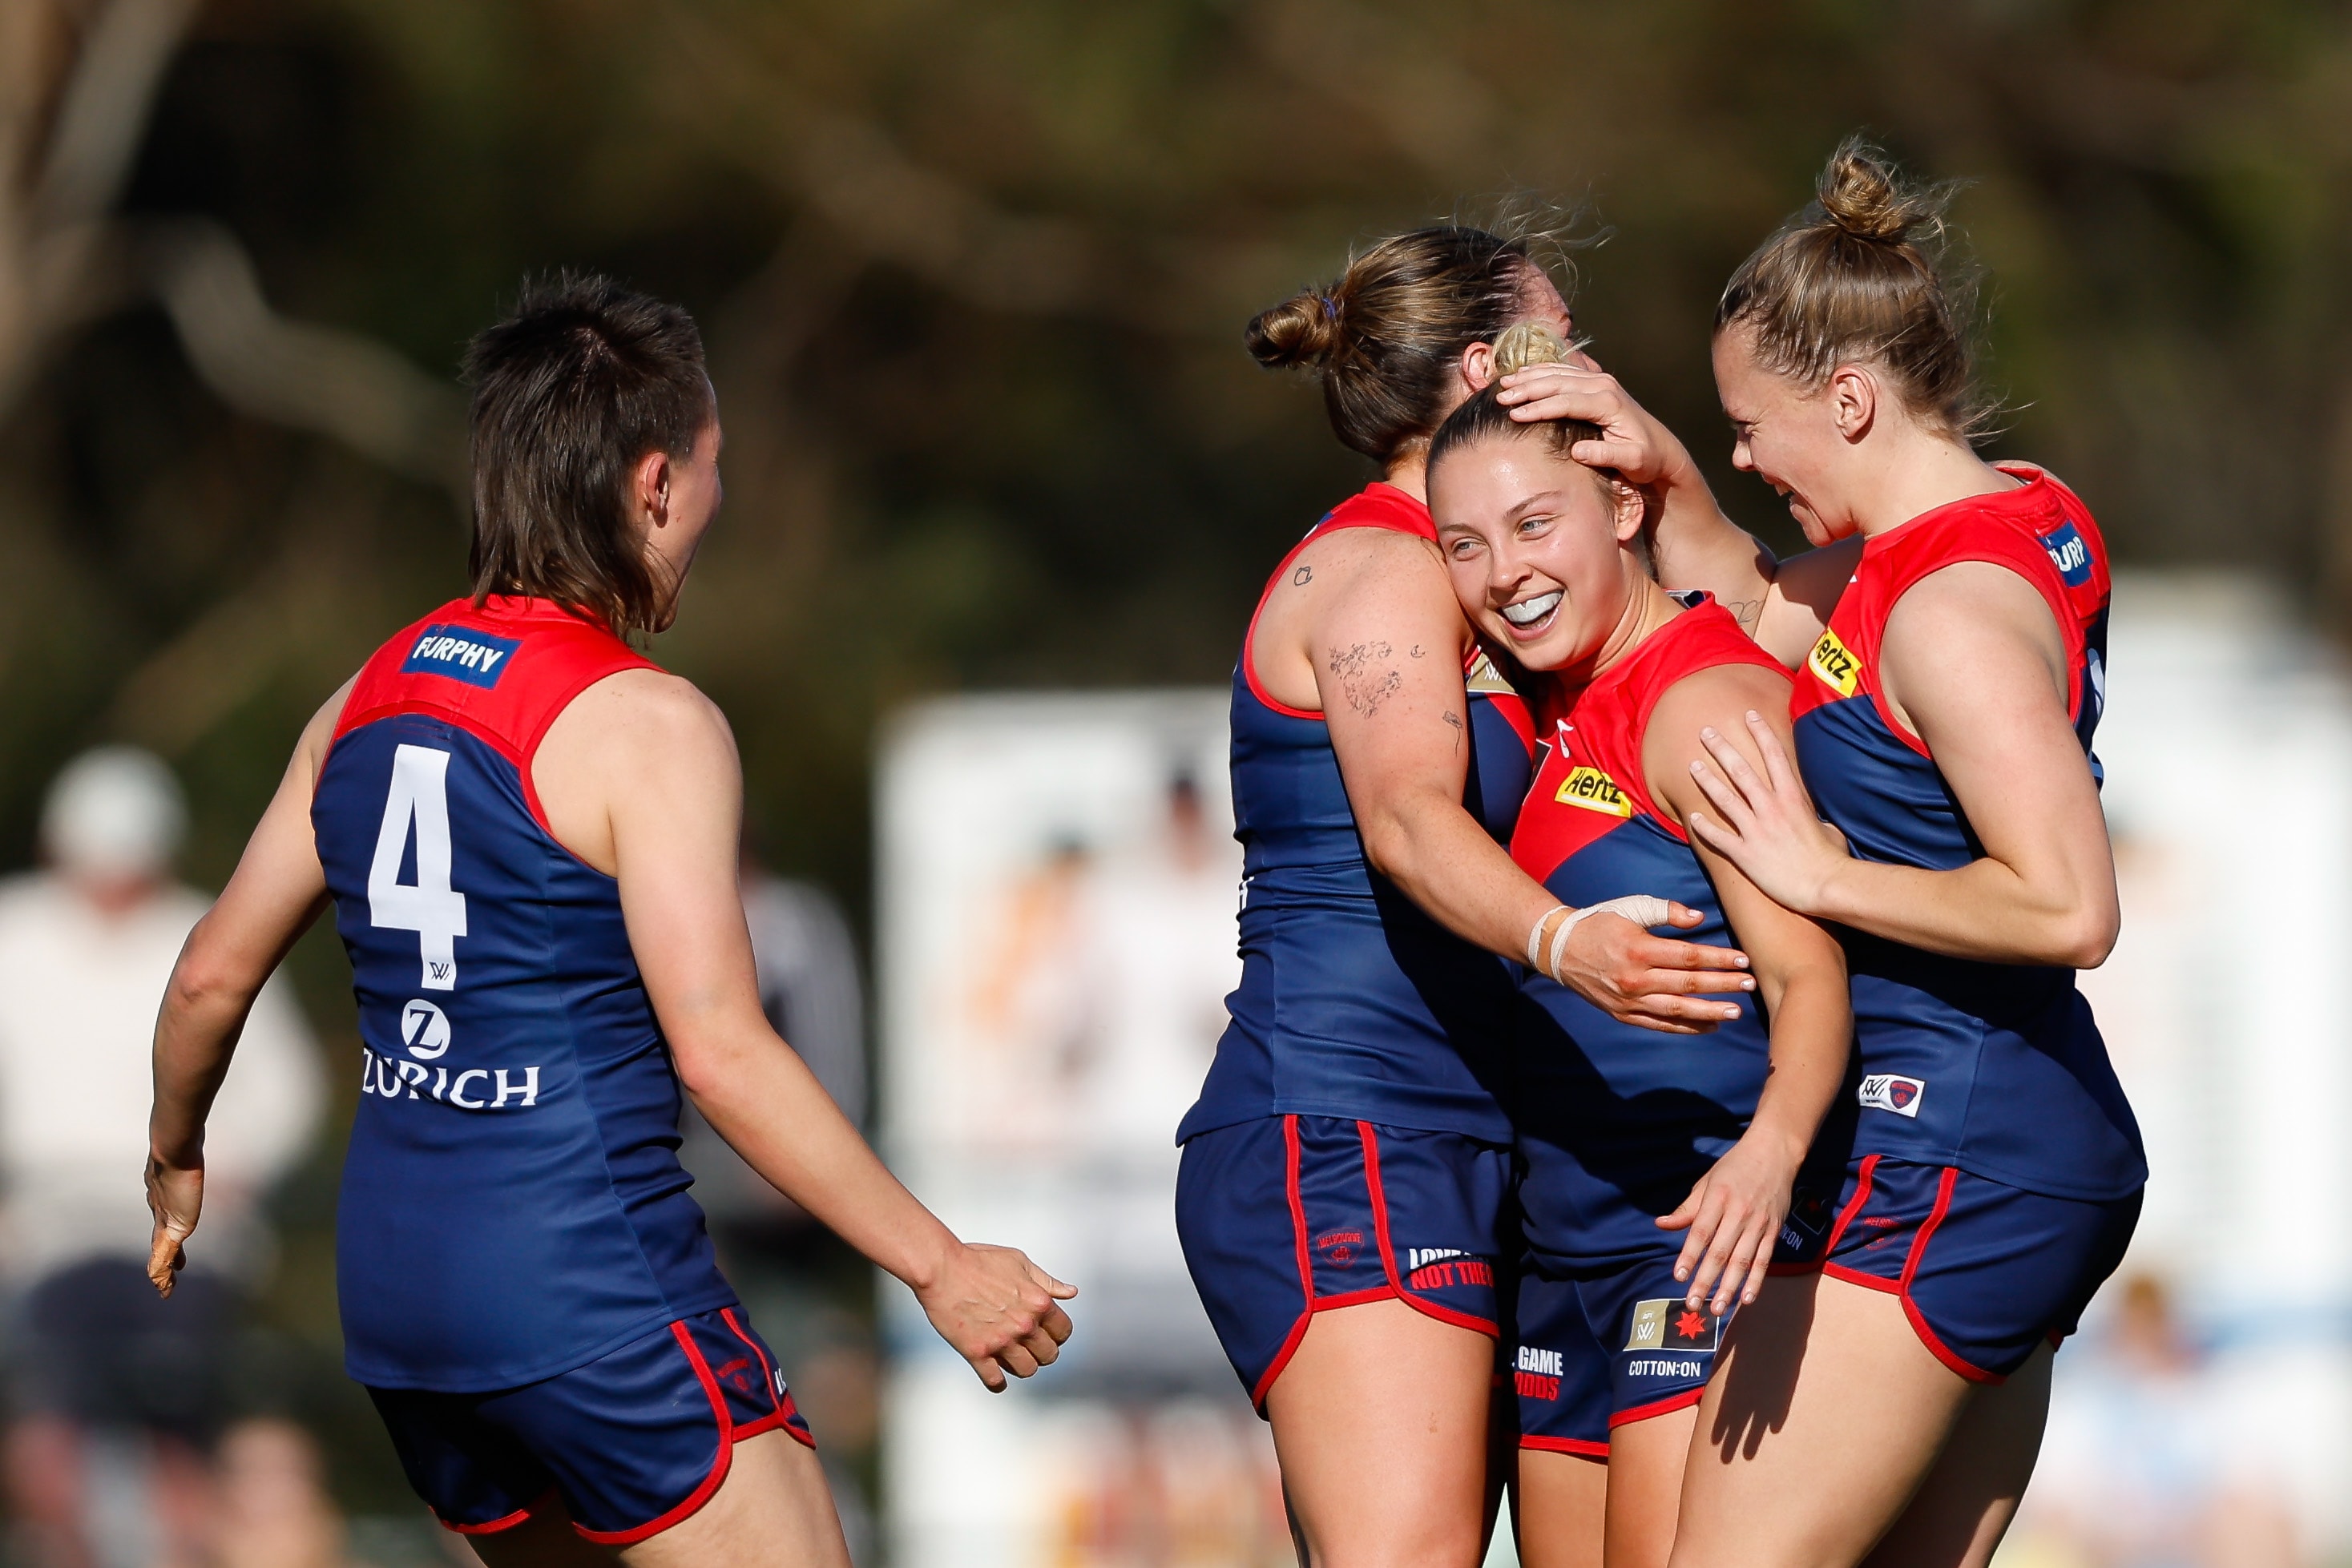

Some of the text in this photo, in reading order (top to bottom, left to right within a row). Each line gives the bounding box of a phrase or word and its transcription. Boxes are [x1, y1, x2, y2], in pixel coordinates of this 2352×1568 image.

[412, 635, 504, 673] FURPHY
[1816, 631, 1852, 681] ertz
[1564, 769, 1621, 804] Hertz
[368, 744, 468, 991] 4
[362, 1046, 541, 1110] ZURICH
[1409, 1264, 1456, 1290] NOT
[1519, 1345, 1563, 1377] GAME
[1628, 1360, 1700, 1377] COTTON:ON
